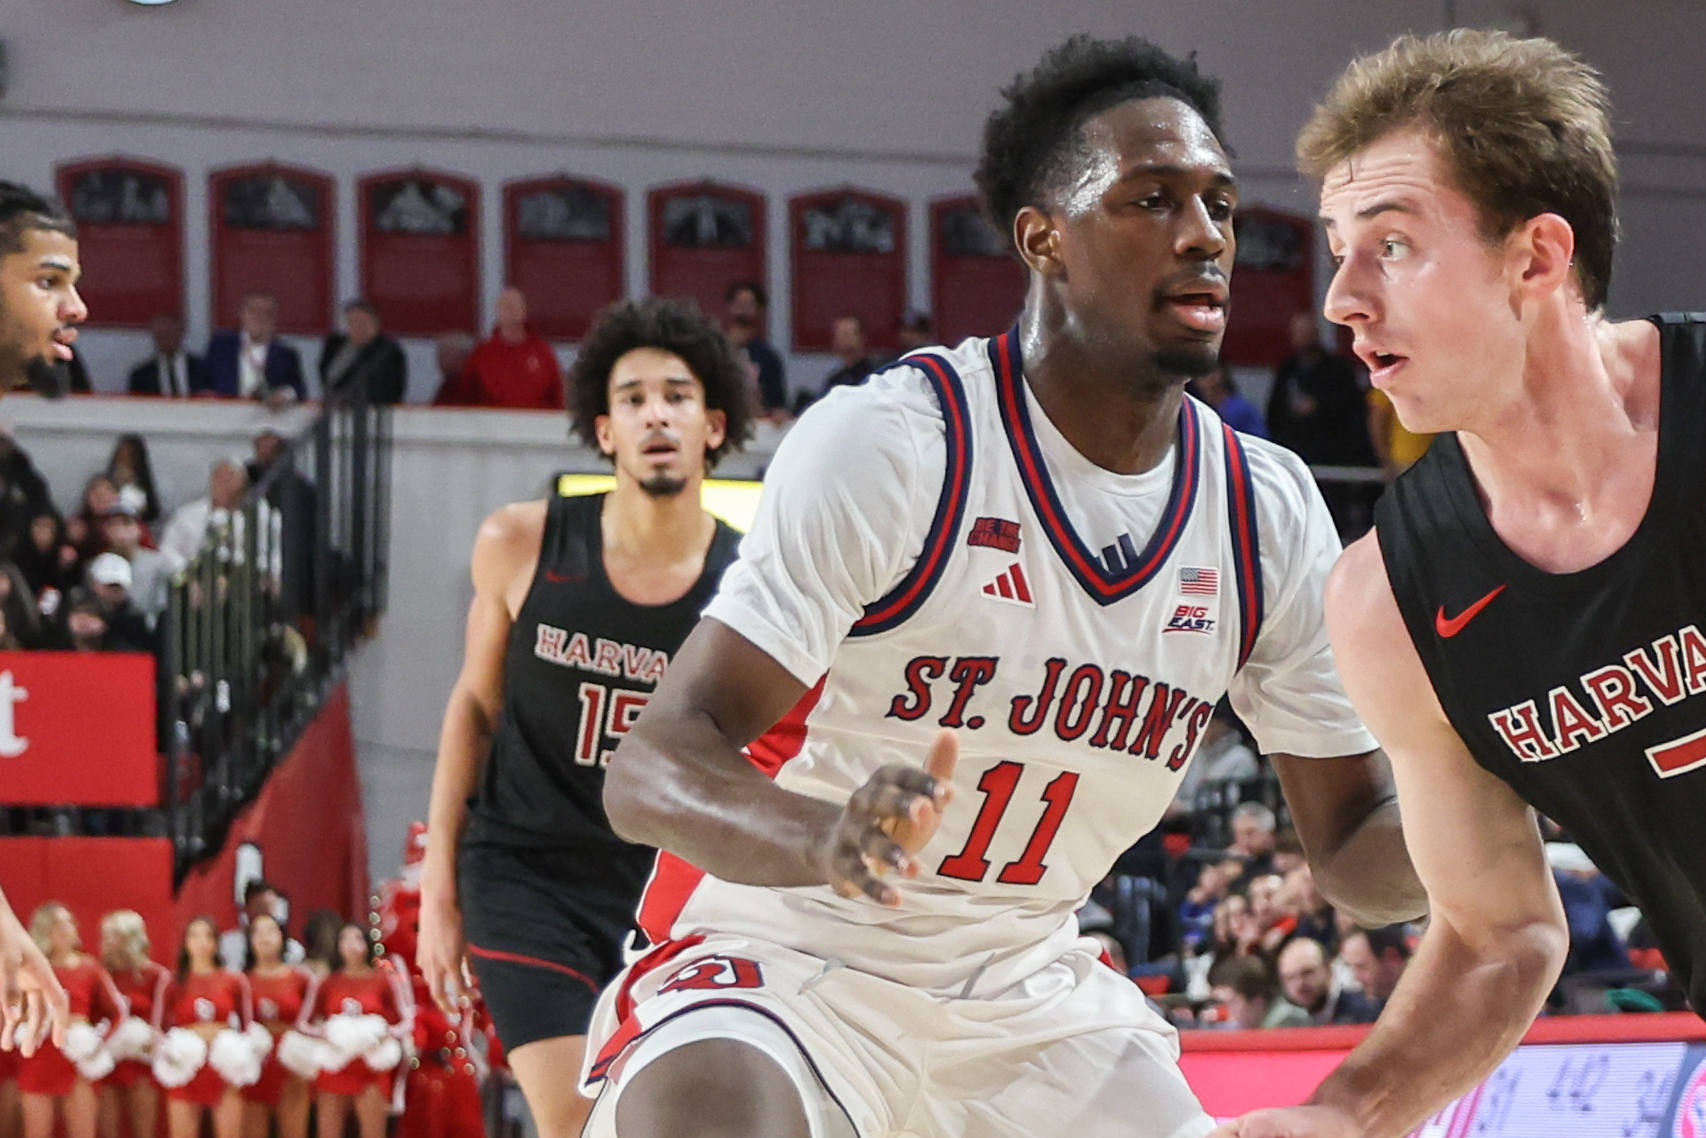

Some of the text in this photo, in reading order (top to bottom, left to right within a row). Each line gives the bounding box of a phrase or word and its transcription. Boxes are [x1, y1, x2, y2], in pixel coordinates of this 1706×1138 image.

[1167, 616, 1216, 631] EAST
[1174, 604, 1209, 619] BIG
[886, 655, 1215, 772] ST. JOHN'S
[936, 760, 1080, 886] 11
